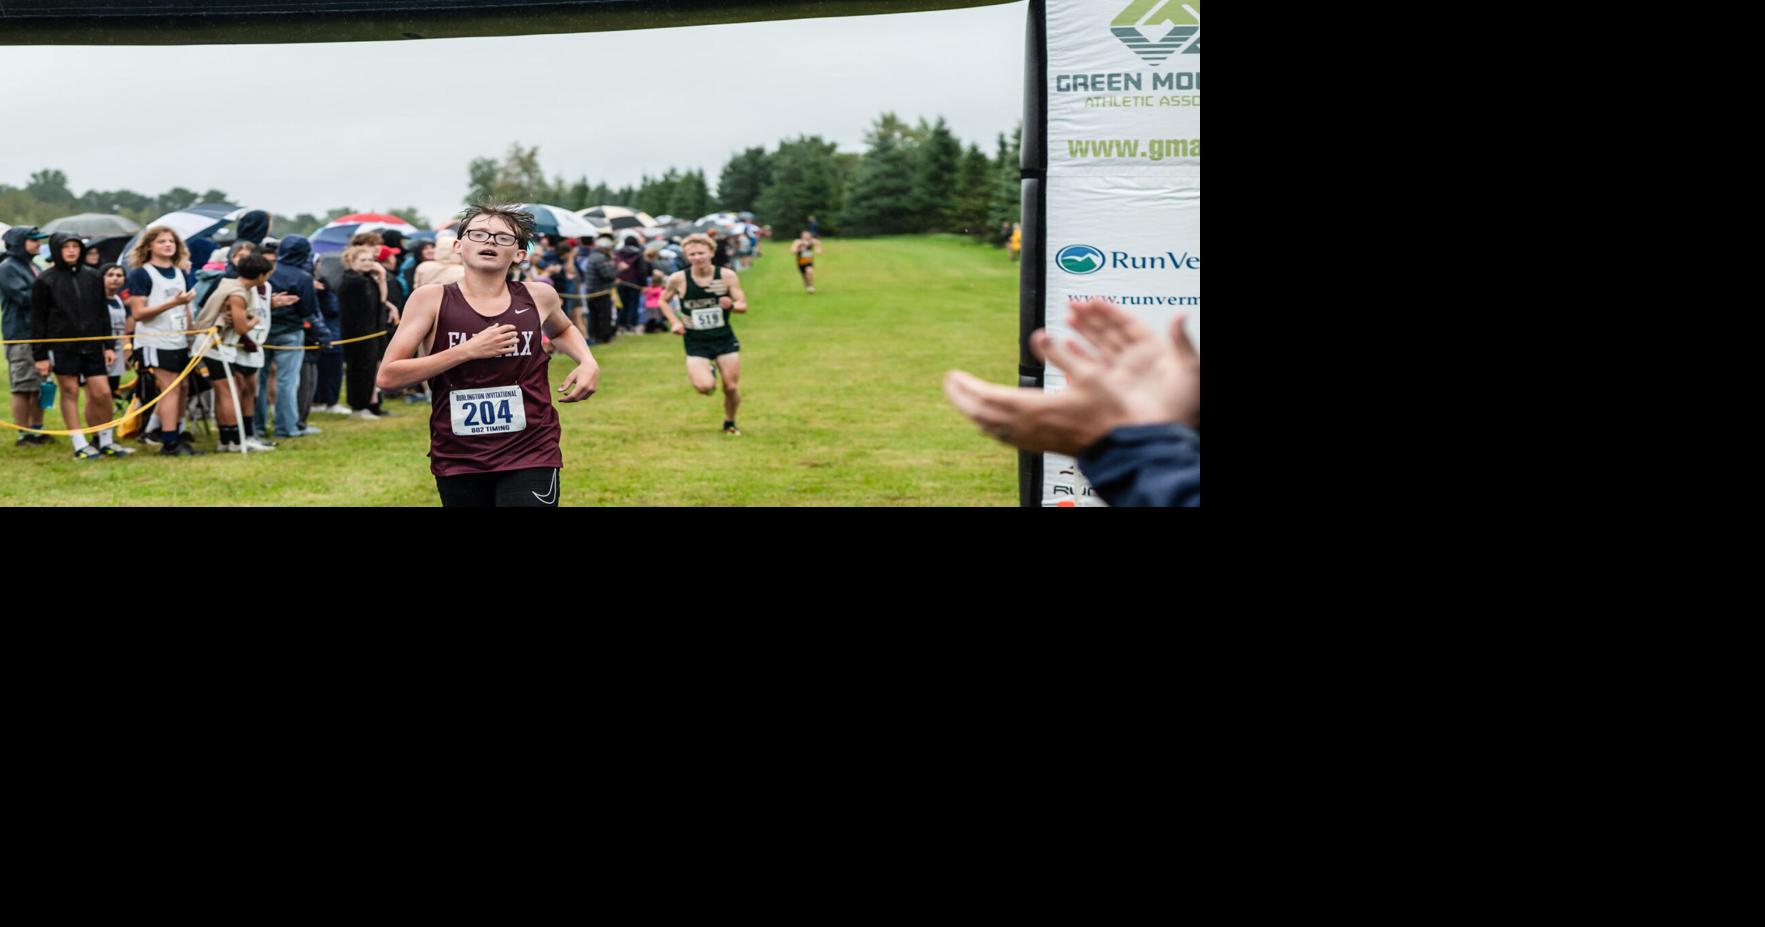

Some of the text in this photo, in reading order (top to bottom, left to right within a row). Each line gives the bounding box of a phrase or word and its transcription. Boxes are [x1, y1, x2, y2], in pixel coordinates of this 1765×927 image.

[1056, 72, 1142, 92] GREEN
[1084, 95, 1153, 108] ATHLETIC
[1067, 138, 1200, 161] www.gma
[1112, 251, 1200, 270] RunVe
[485, 390, 517, 399] INVITATIONAL
[462, 400, 513, 426] 204
